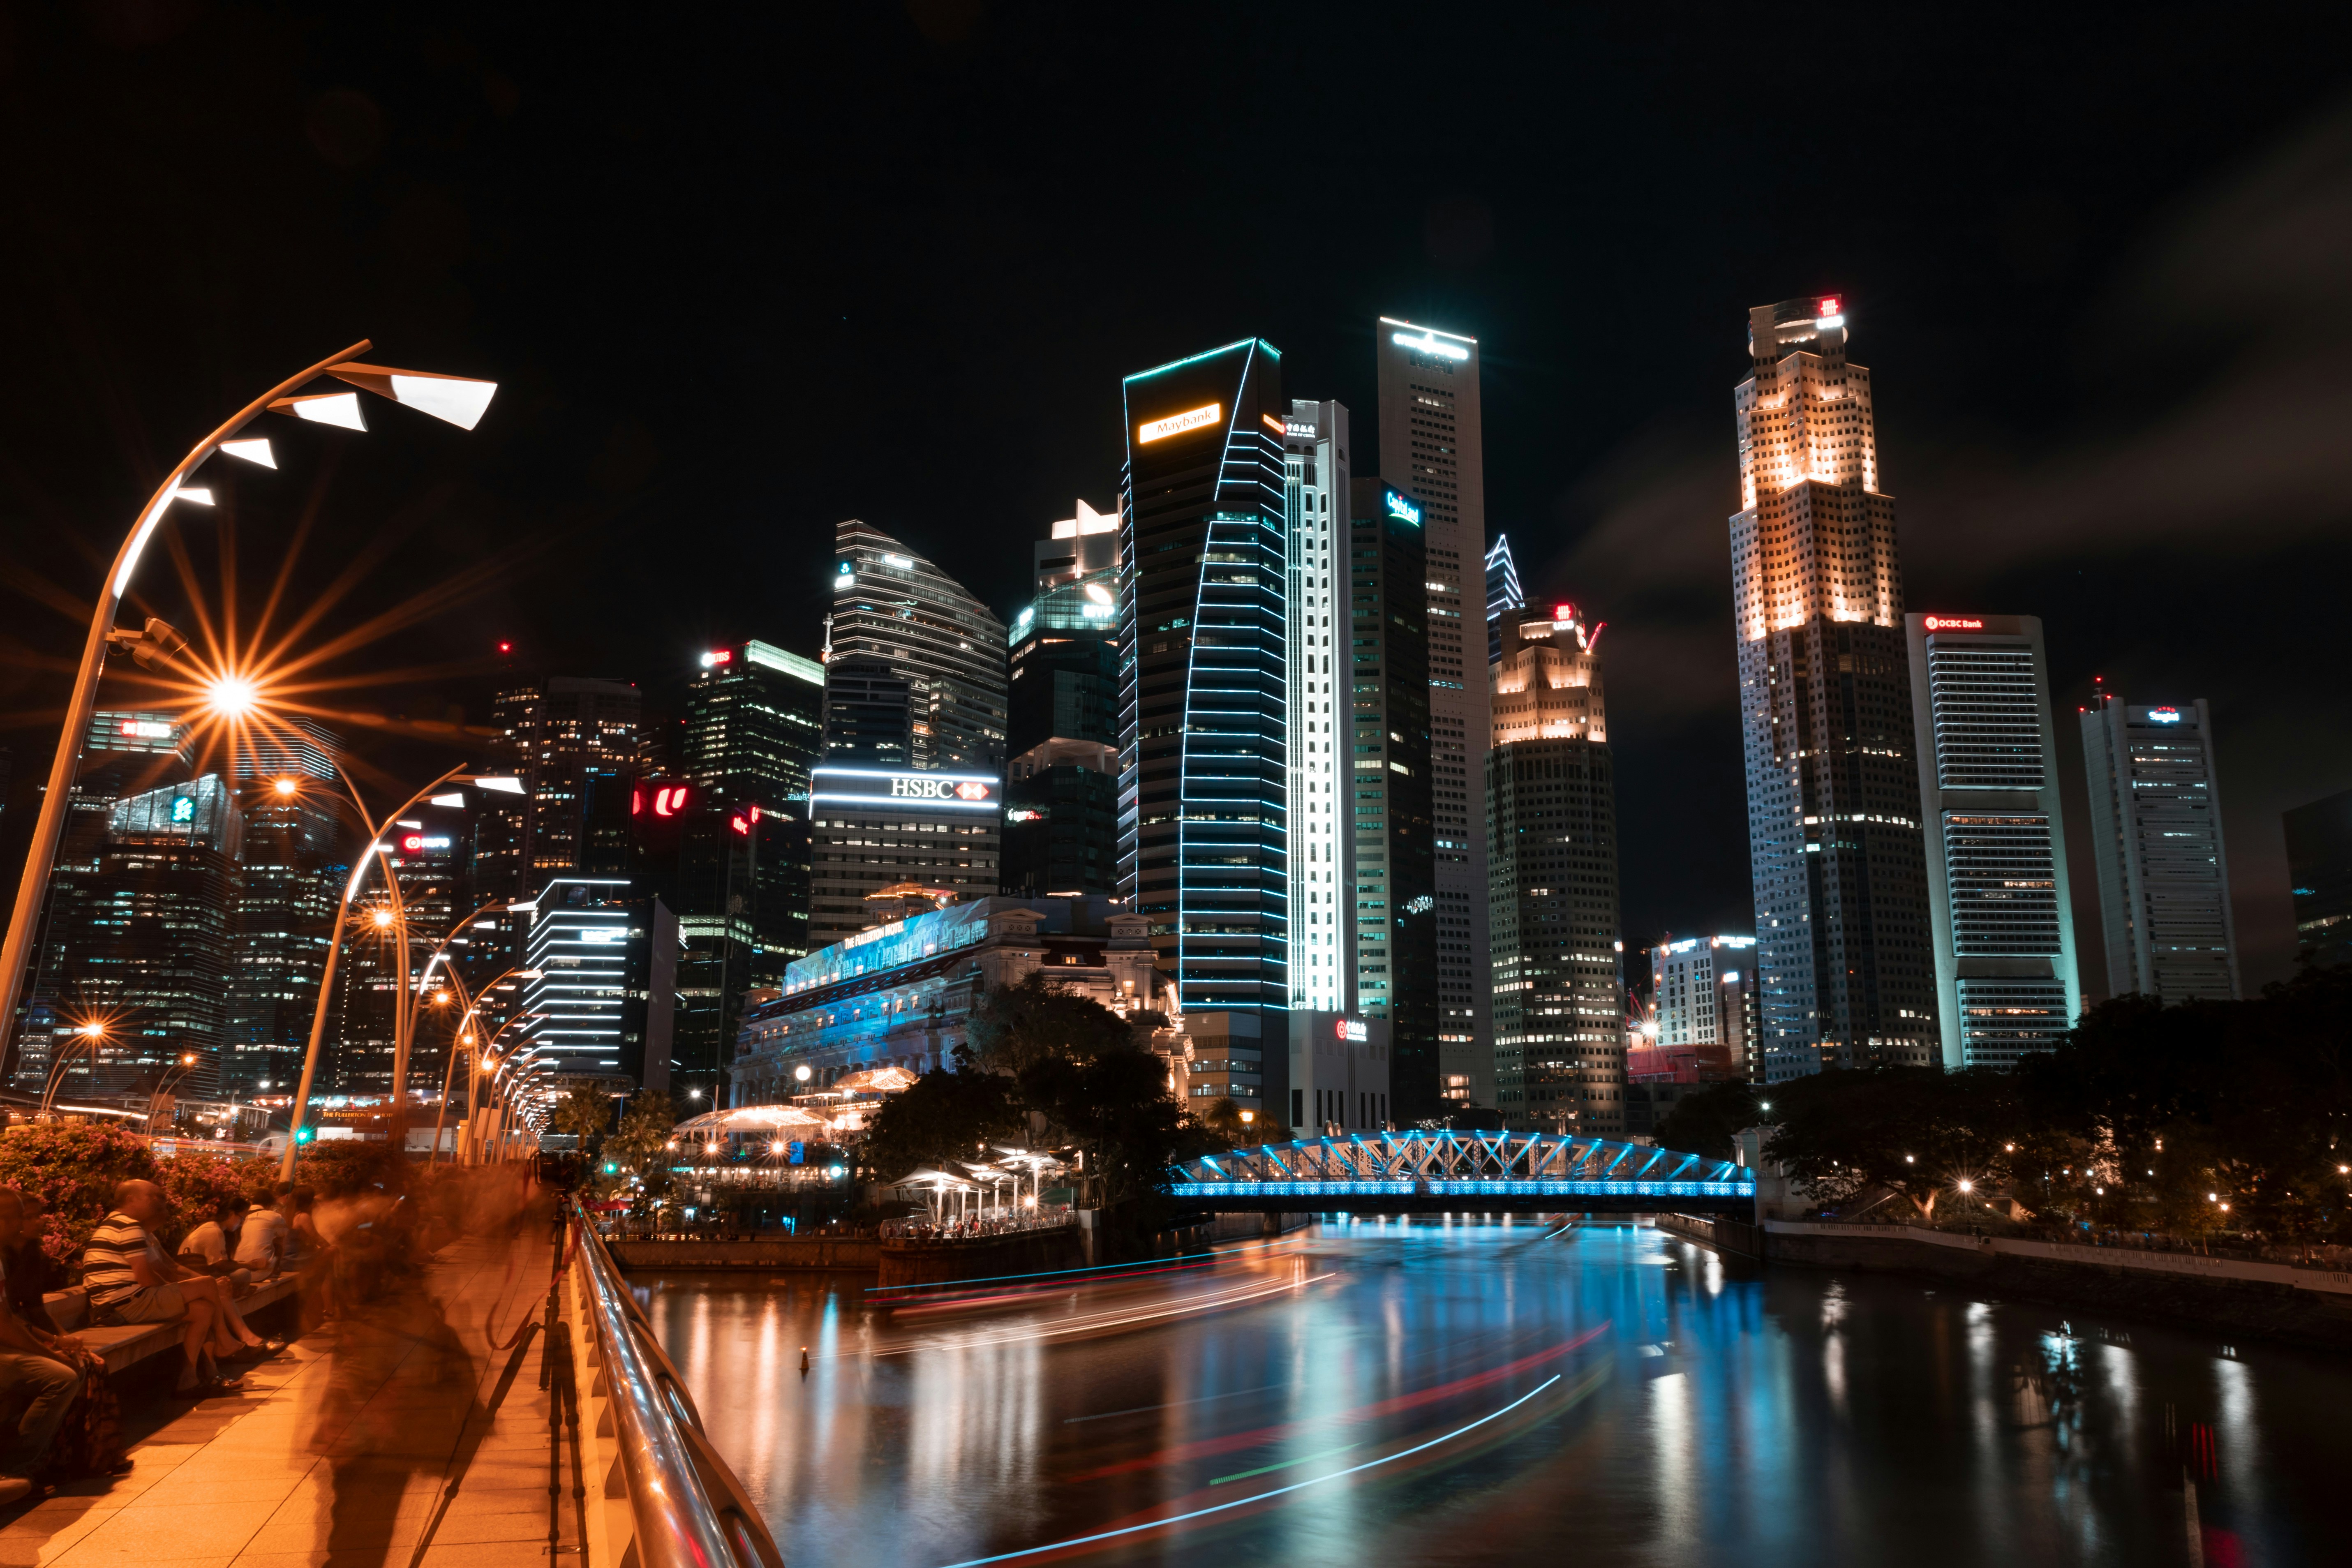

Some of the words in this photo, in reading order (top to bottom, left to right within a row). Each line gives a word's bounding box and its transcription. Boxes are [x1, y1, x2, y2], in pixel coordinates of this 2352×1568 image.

[1158, 410, 1211, 434] Maybank
[1553, 620, 1574, 630] UOB
[1962, 620, 1982, 628] Bank
[712, 651, 730, 663] UBS
[891, 778, 953, 799] HSBC
[845, 938, 855, 949] THE
[855, 927, 885, 947] FULLERTON
[885, 921, 904, 937] HOTEL
